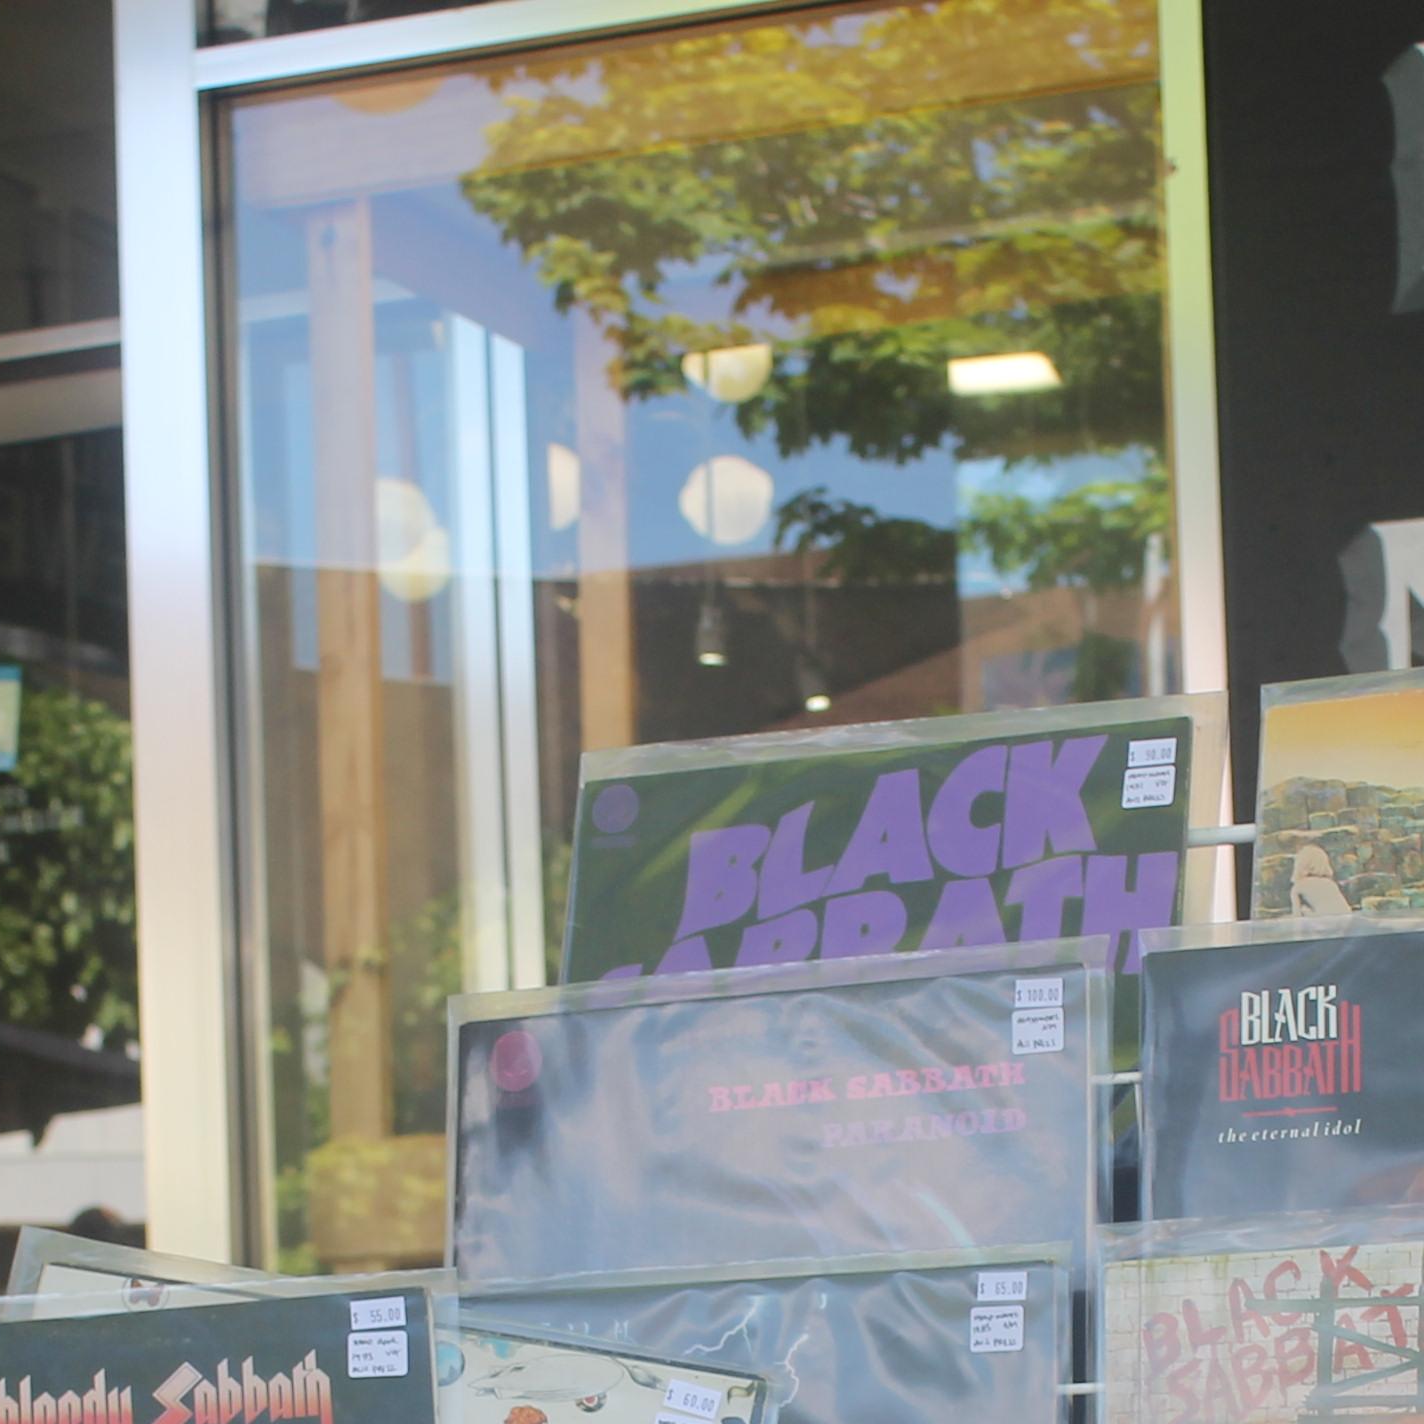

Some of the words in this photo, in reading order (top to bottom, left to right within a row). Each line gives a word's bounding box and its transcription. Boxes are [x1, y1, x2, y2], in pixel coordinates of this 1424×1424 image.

[674, 735, 1108, 942] BLACK
[1017, 989, 1022, 1002] $
[1027, 988, 1060, 1001] 100.00
[1241, 985, 1338, 1045] BLACK
[1219, 1000, 1361, 1103] SABBATH
[707, 1076, 836, 1112] BLACK
[846, 1062, 1025, 1100] SABBATH
[820, 1109, 1027, 1148] PARANOID
[1251, 1121, 1320, 1141] eternal
[1324, 1118, 1362, 1135] idol
[980, 1282, 985, 1295] $
[995, 1281, 1024, 1295] 65.00
[353, 1312, 359, 1324] $
[369, 1307, 401, 1323] 55.00
[1143, 1245, 1374, 1373] BLACK
[666, 1389, 674, 1400] $
[682, 1392, 715, 1412] 60.00
